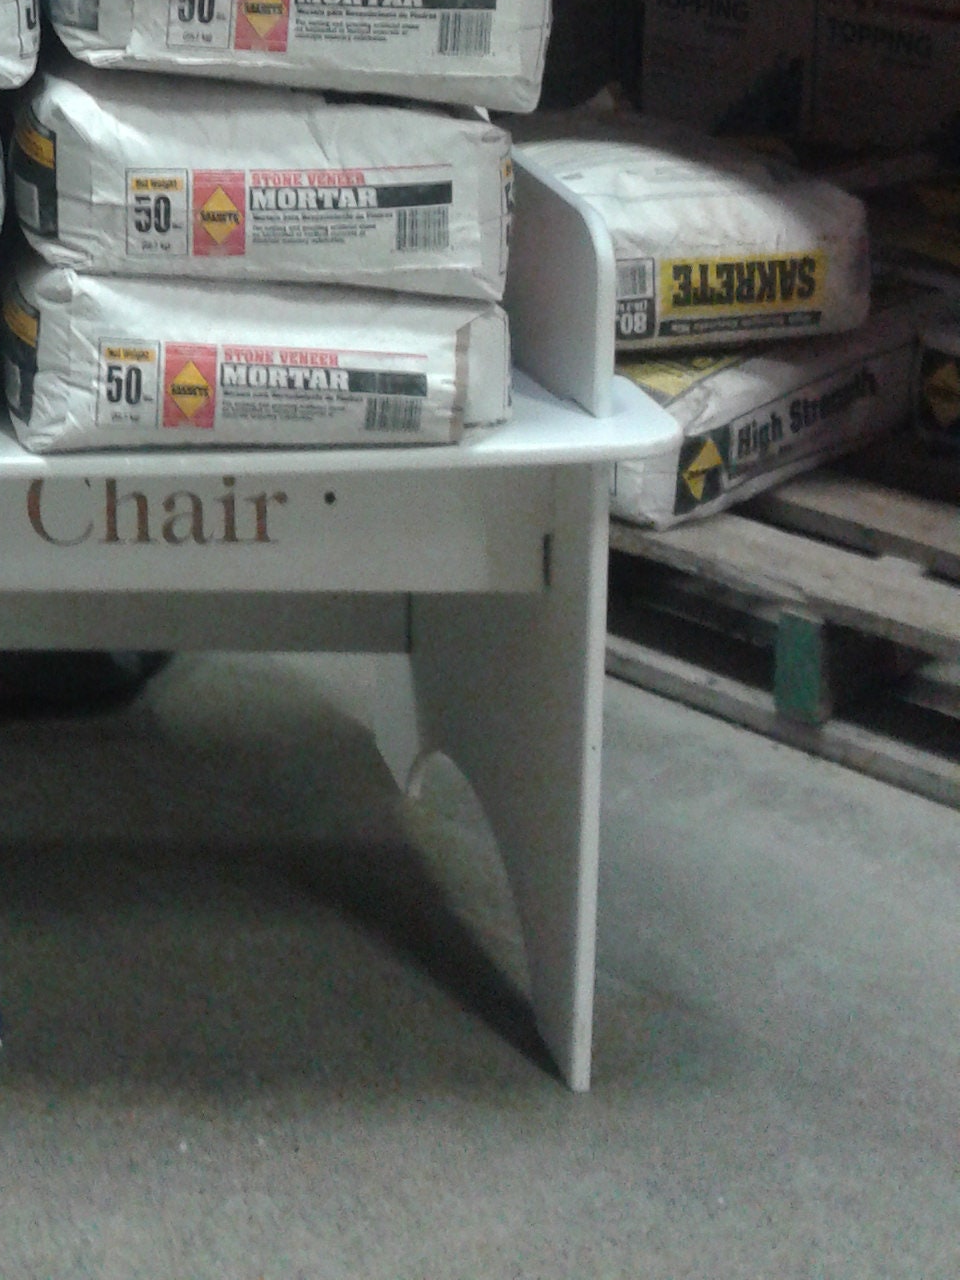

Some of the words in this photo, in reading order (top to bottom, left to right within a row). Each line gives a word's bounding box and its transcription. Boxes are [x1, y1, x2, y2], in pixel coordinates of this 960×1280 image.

[828, 16, 933, 59] TOPPING
[250, 185, 379, 211] MORTAR
[251, 172, 301, 187] STONE
[307, 171, 366, 187] VENEER
[133, 195, 172, 234] 50
[672, 257, 816, 307] SAKRETE
[221, 361, 350, 393] MORTAR
[224, 348, 274, 365] STONE
[280, 350, 339, 367] VENEER
[106, 364, 141, 405] 50
[26, 476, 290, 549] Chair
